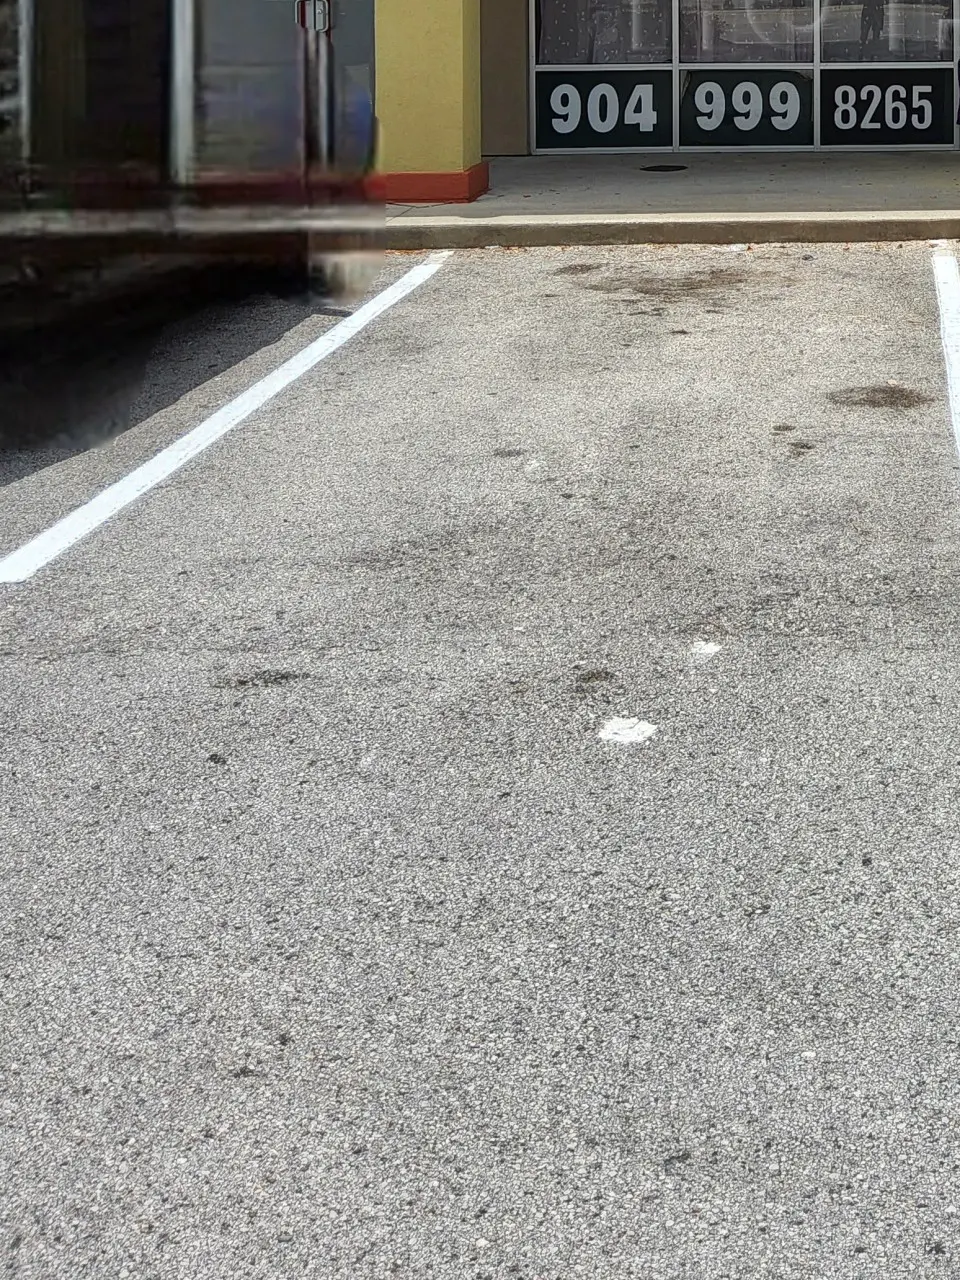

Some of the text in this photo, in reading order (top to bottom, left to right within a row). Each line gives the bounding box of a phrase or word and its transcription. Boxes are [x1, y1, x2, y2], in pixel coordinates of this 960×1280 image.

[549, 81, 932, 134] 904 999 8265
